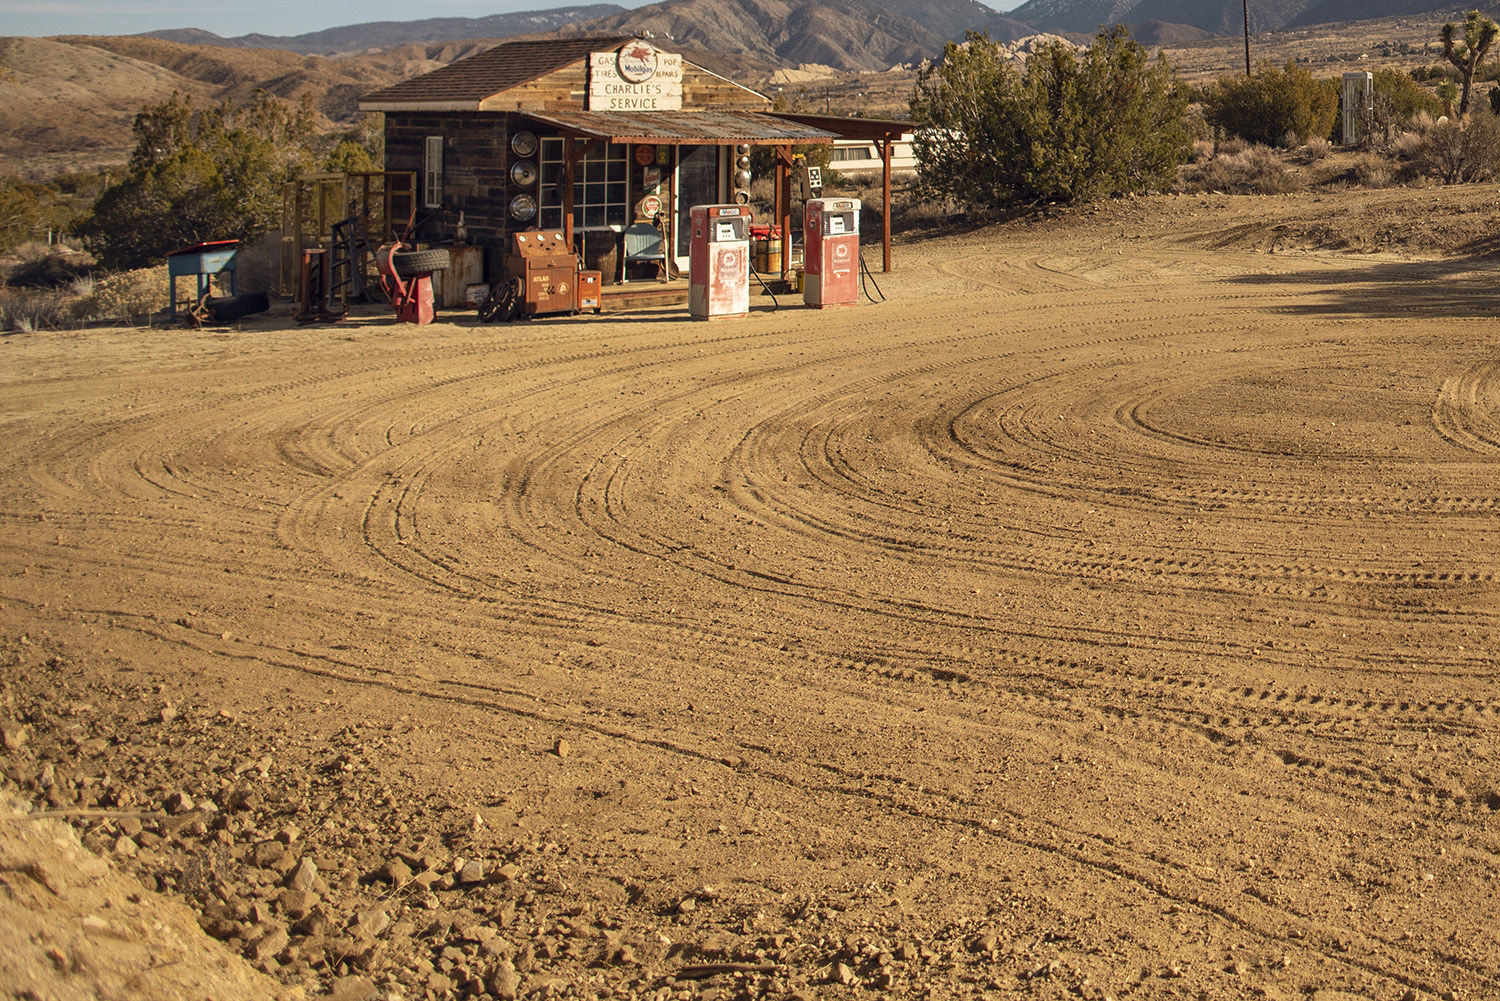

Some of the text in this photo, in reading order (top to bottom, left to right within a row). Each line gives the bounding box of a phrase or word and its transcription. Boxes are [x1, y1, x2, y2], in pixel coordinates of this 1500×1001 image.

[598, 56, 615, 66] GAS
[663, 58, 677, 66] POP
[595, 69, 617, 78] TIRES
[624, 64, 653, 74] Mobilgas
[604, 84, 662, 95] CHARLIE'S
[609, 98, 657, 109] SERVICE
